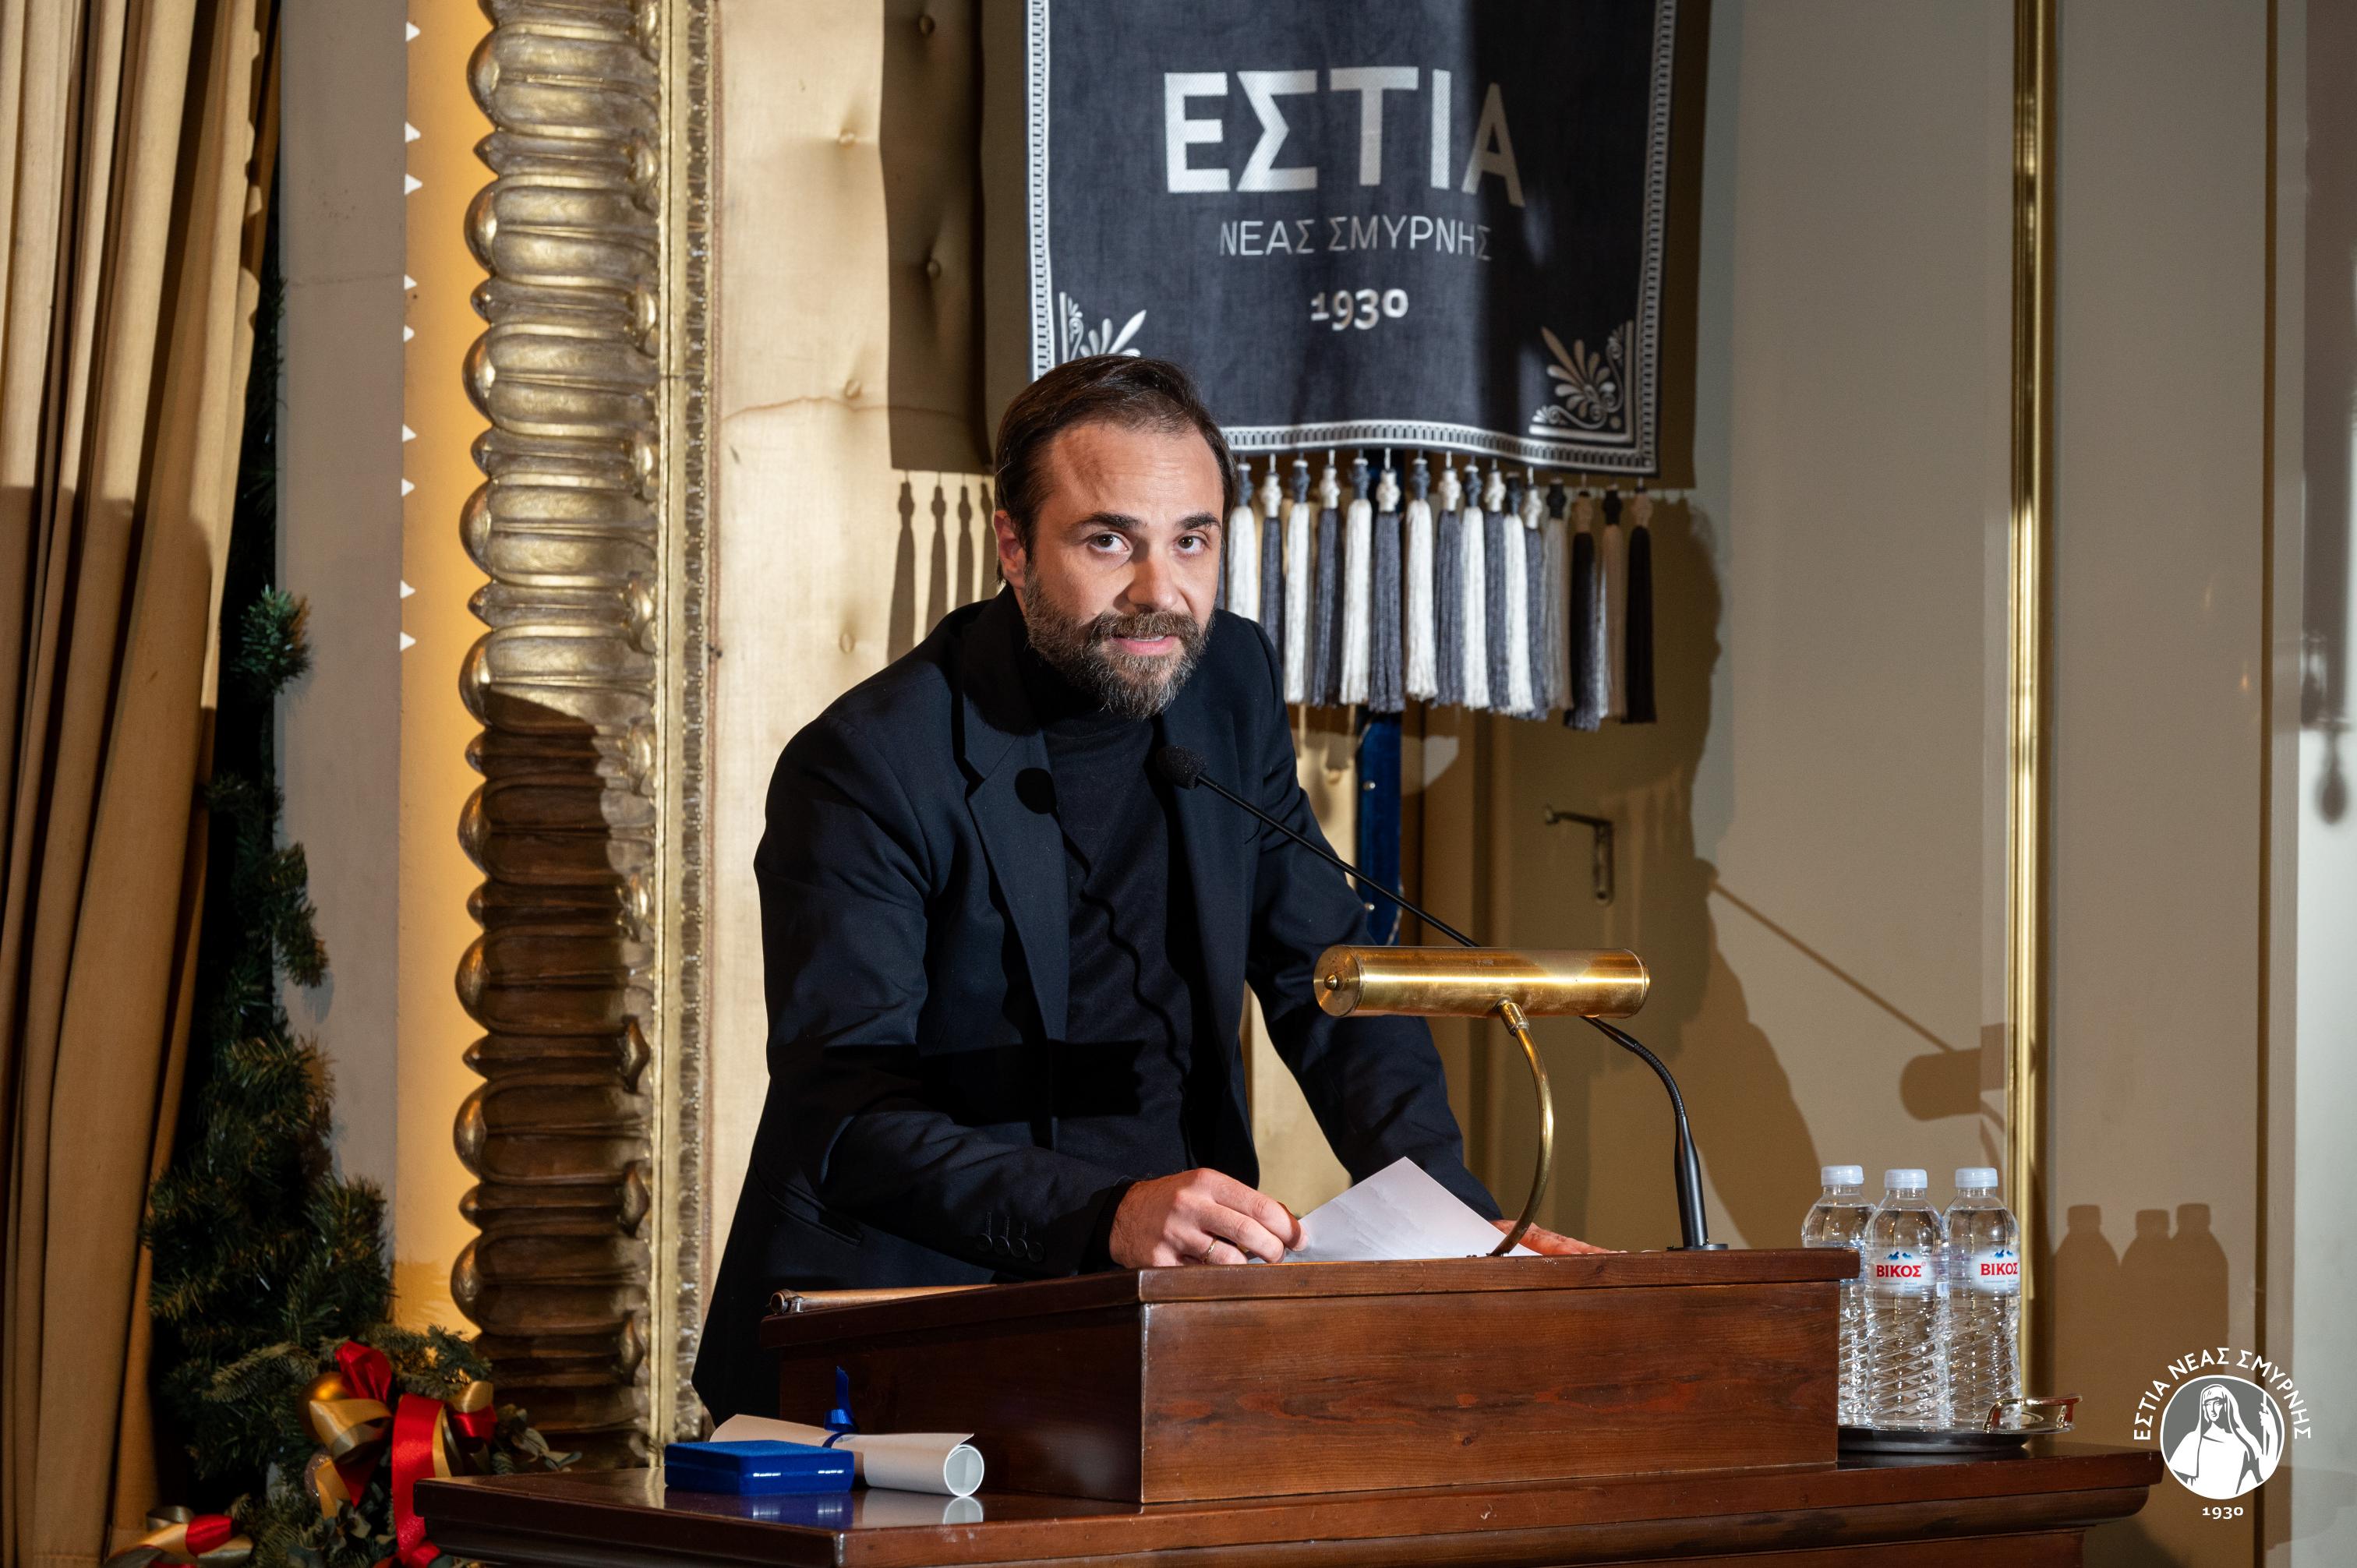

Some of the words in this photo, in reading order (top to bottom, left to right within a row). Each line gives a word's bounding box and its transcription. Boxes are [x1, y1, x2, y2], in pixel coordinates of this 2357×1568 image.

[1164, 66, 1525, 207] ΕΣΤΙΑ
[1219, 219, 1316, 256] ΝΕΑΣ
[1328, 214, 1493, 261] ΣΜΥΡΝΗΣ
[1310, 288, 1409, 331] 1930
[1876, 1264, 1922, 1278] ΒΙΚΟΣ
[1981, 1262, 2019, 1276] ΒΙΚΟΣ
